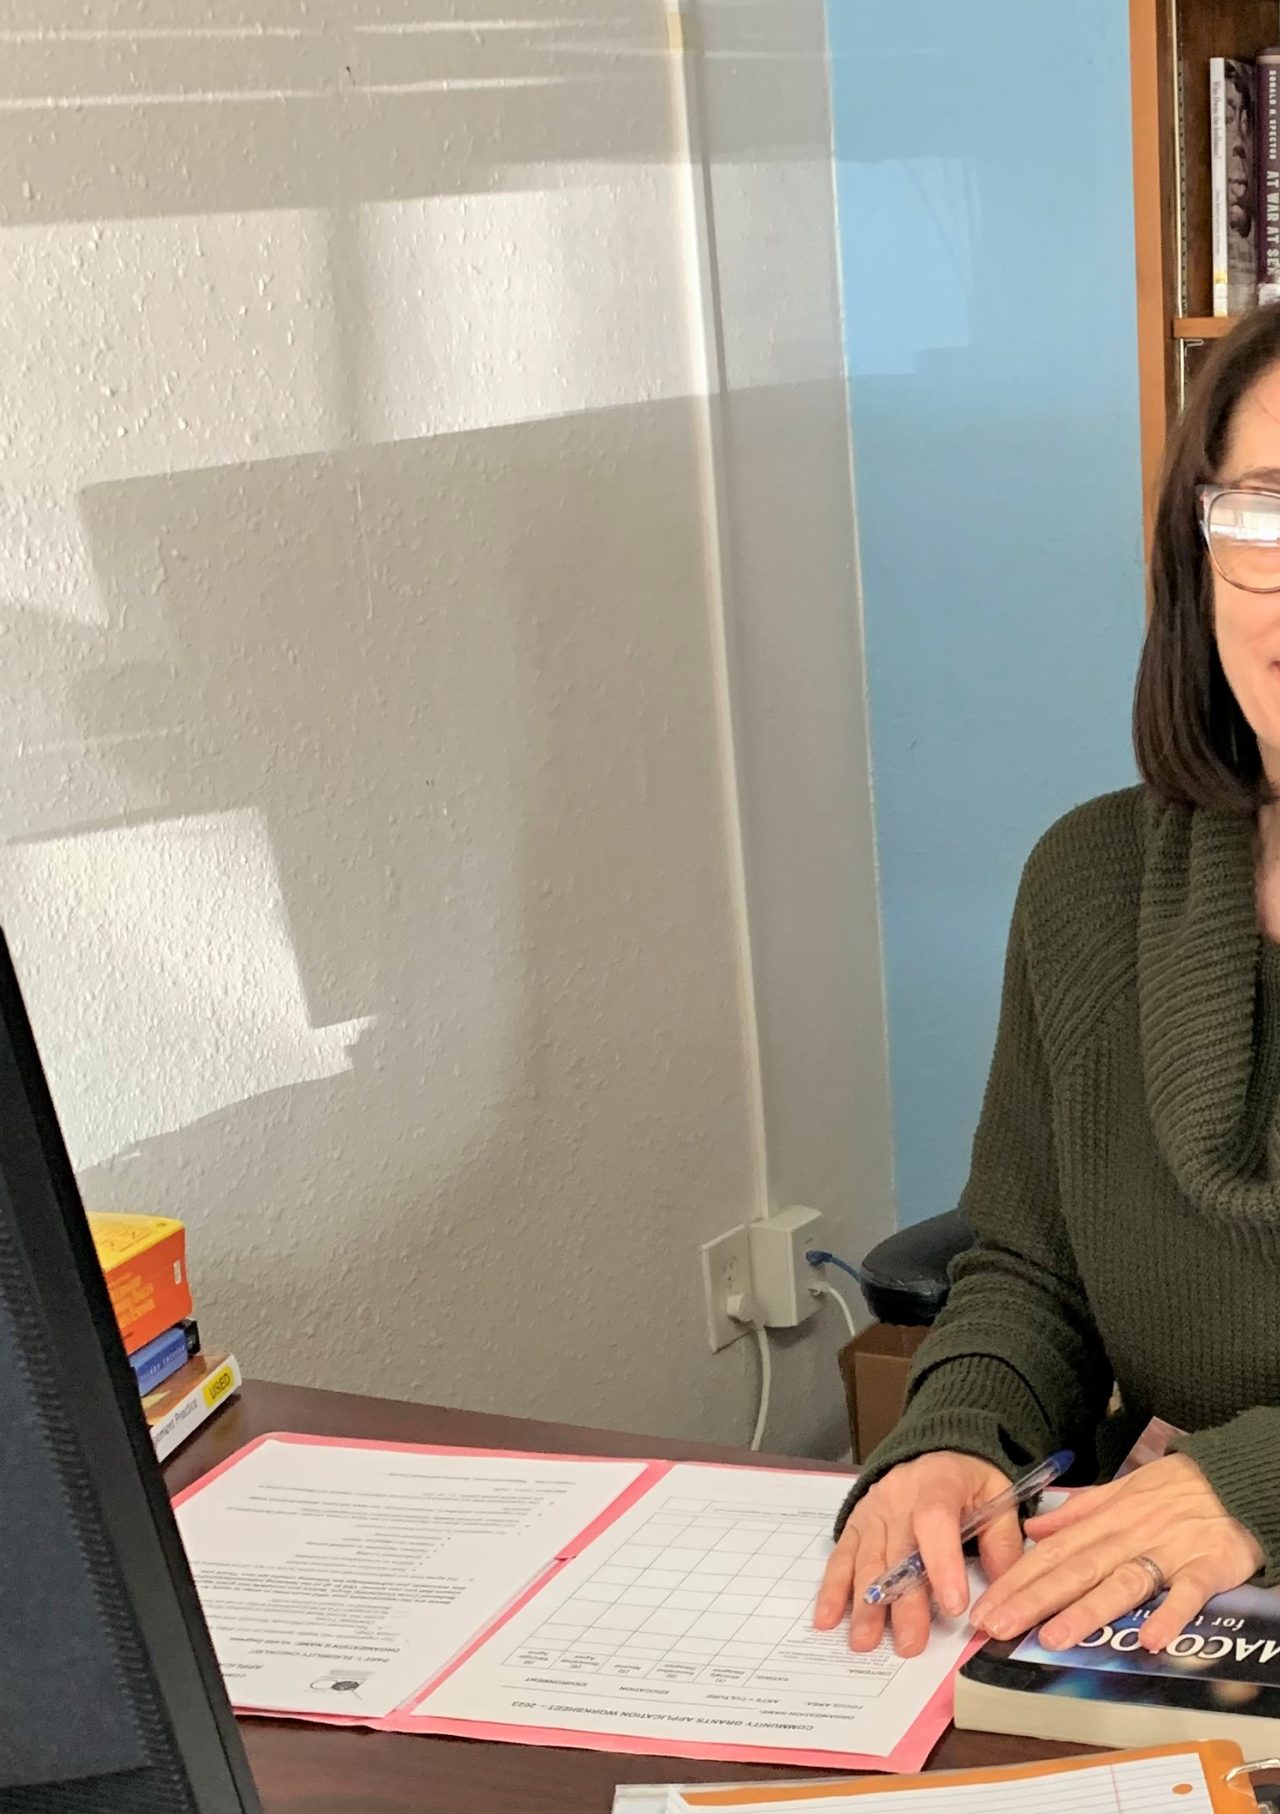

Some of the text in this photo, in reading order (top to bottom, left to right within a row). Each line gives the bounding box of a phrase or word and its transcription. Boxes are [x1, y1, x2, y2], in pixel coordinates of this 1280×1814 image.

[1268, 70, 1277, 160] RONALD SPECTOR
[1266, 171, 1279, 187] AT
[1266, 192, 1279, 221] WAR
[1266, 226, 1279, 243] AT
[207, 1371, 231, 1400] USED
[1210, 1616, 1246, 1632] for
[511, 1701, 815, 1731] COMMUNITY GRANTS APPLICATION WORKSHEET 2023
